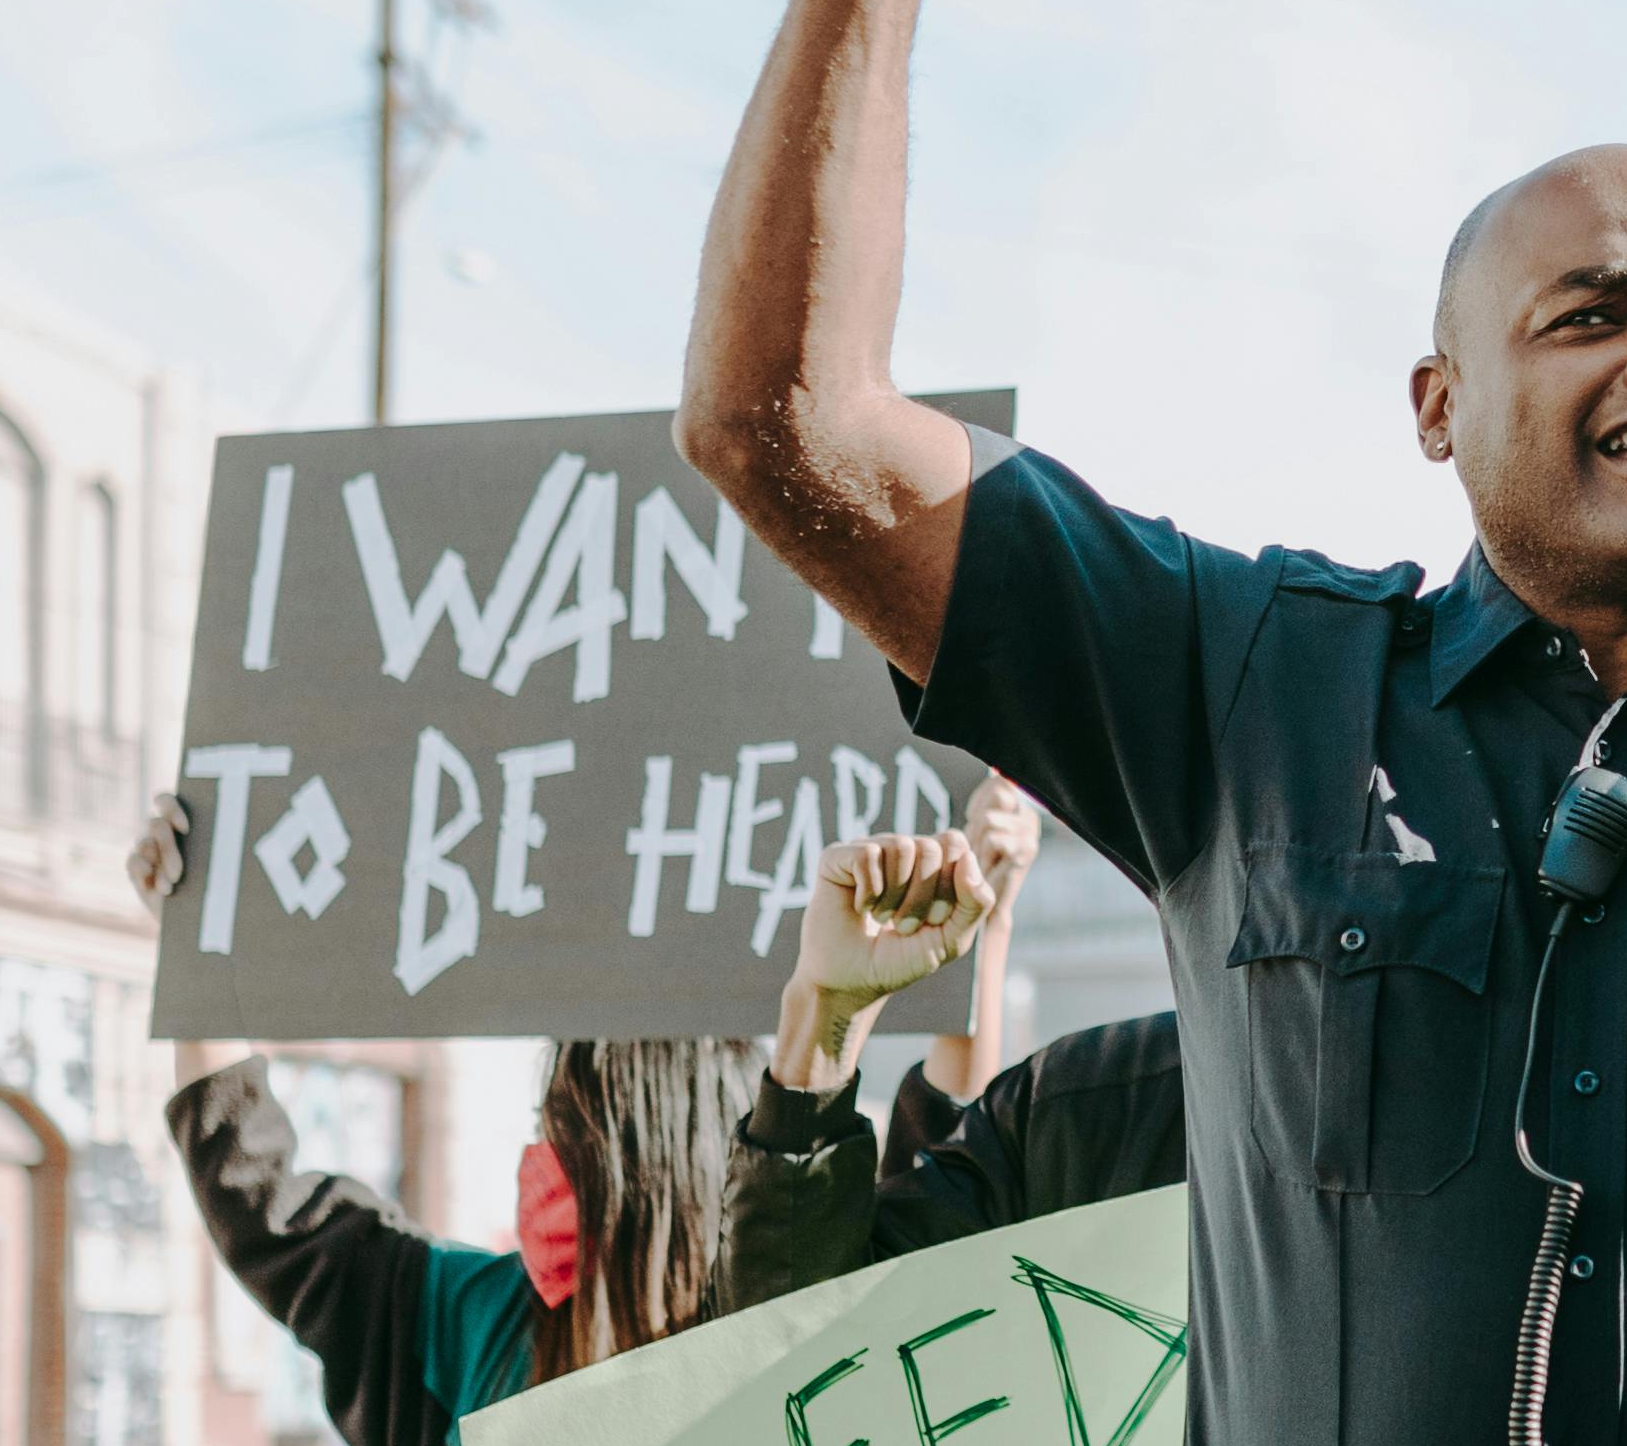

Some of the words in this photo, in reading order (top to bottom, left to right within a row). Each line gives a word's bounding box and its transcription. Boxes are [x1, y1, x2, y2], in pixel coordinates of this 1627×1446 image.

[243, 463, 293, 671] I
[184, 741, 350, 955] TO
[393, 725, 575, 997] BE
